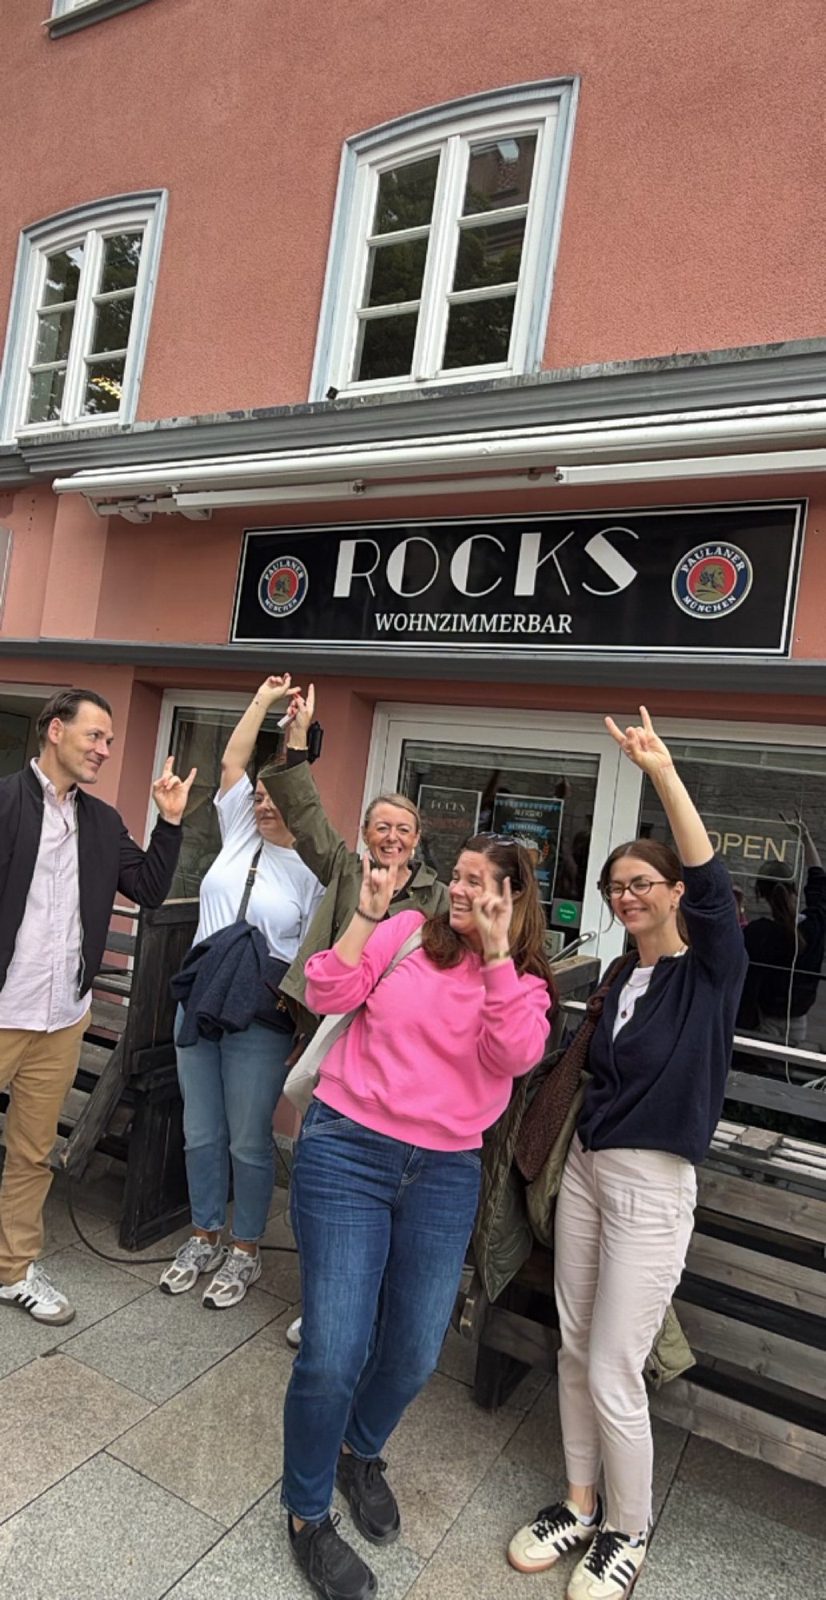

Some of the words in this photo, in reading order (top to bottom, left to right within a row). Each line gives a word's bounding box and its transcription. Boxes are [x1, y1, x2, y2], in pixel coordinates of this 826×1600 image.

[263, 559, 304, 580] PAULANER
[333, 527, 639, 597] ROCKS
[680, 547, 746, 573] PAULANER
[375, 613, 573, 633] WOHNZIMMERBAR
